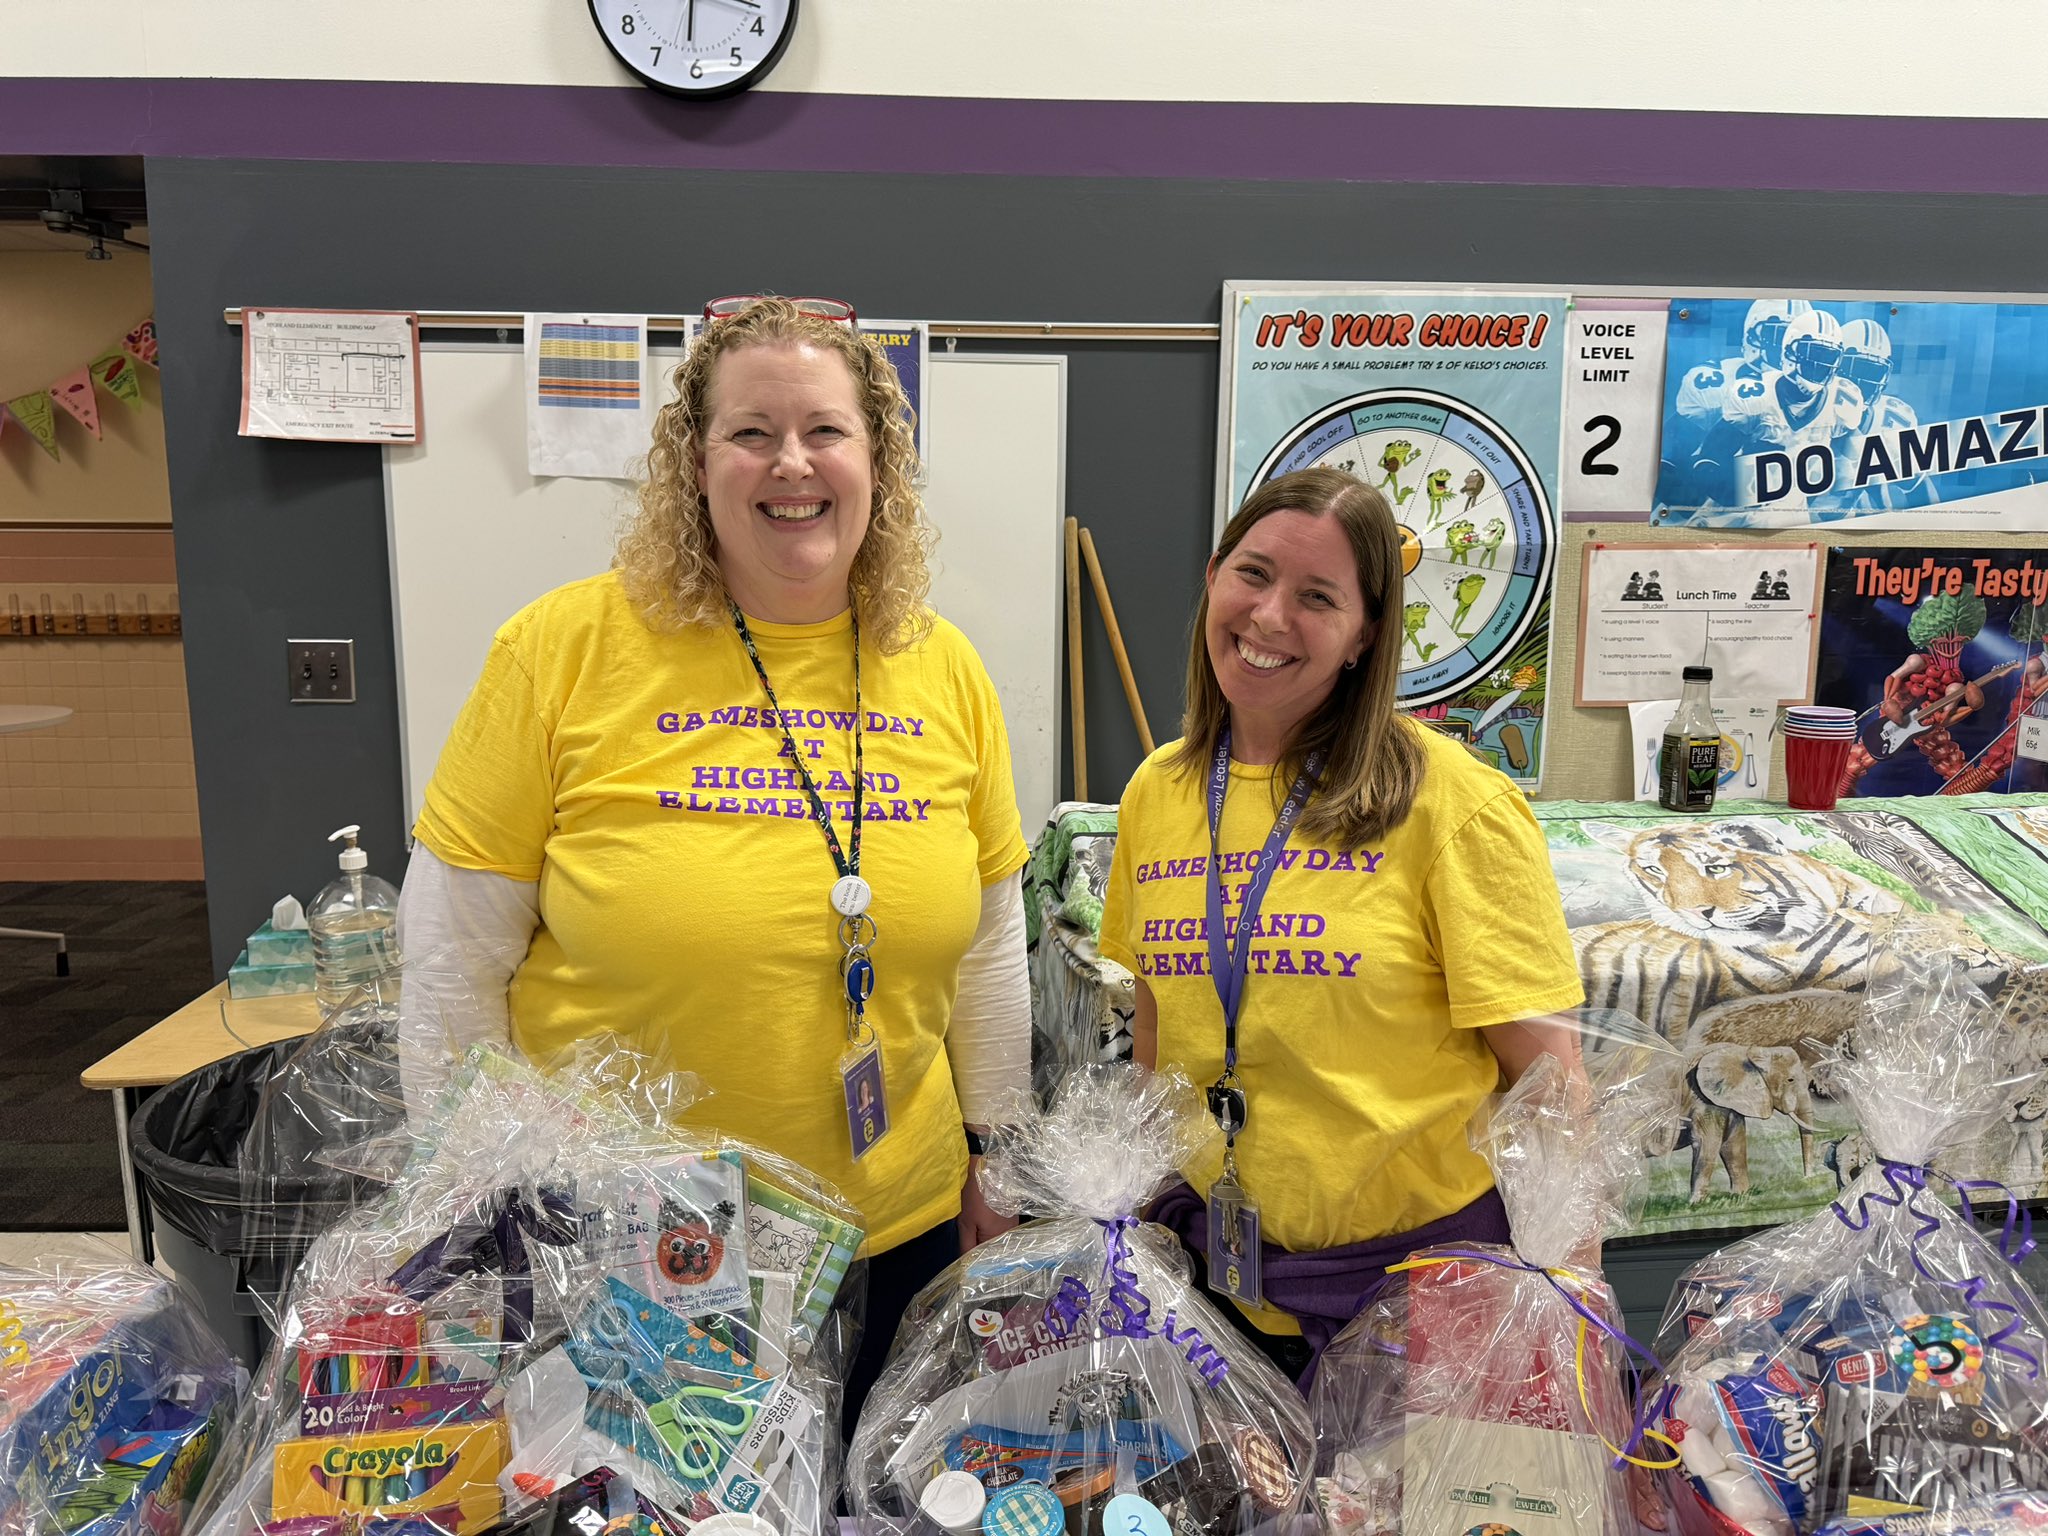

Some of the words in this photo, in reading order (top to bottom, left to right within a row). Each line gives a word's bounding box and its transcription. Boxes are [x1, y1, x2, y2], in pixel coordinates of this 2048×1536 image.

[621, 14, 636, 36] 8
[749, 16, 765, 37] 4
[650, 46, 662, 67] 7
[729, 47, 743, 67] 5
[689, 58, 703, 80] 6
[1256, 310, 1323, 347] IT'S
[1331, 313, 1414, 347] YOUR
[1583, 323, 1636, 338] VOICE
[1580, 345, 1635, 361] LEVEL
[1252, 361, 1268, 370] DO
[1270, 361, 1292, 370] YOU
[1294, 361, 1320, 370] HAVE
[1321, 361, 1329, 370] A
[1331, 361, 1360, 370] SMALL
[1363, 360, 1415, 370] PROBLEM?
[1418, 361, 1434, 370] TRY
[1436, 361, 1444, 370] 2
[1445, 361, 1462, 370] OF
[1463, 360, 1501, 370] KELSO'S
[1582, 368, 1631, 383] LIMIT
[1357, 416, 1371, 426] GO
[1371, 414, 1383, 422] TO
[1384, 411, 1420, 421] ANOTHER
[1420, 414, 1442, 426] GAME
[1306, 436, 1327, 454] COOL
[1327, 424, 1344, 439] OFF
[1465, 432, 1483, 447] TALK
[1485, 449, 1501, 466] OUT
[1580, 414, 1622, 476] 2
[1755, 444, 1834, 504] DO
[1853, 557, 1963, 605] They're
[1641, 602, 1669, 610] Student
[1676, 590, 1709, 600] Lunch
[1712, 590, 1737, 600] Time
[1412, 675, 1431, 687] WALK
[1431, 667, 1449, 683] AWAY
[866, 711, 925, 737] DAY
[2027, 726, 2041, 737] Milk
[777, 737, 825, 759] AT
[1692, 746, 1717, 757] PURE
[2025, 739, 2038, 751] 65¢
[1212, 745, 1228, 790] Leader
[1303, 849, 1384, 874] DAY
[996, 1325, 1031, 1354] ICE
[98, 1389, 119, 1424] ZING
[304, 1405, 334, 1429] 20
[775, 1394, 797, 1425] KIDS
[1873, 1402, 1890, 1421] SIZE
[749, 1389, 788, 1450] SCISSORS
[323, 1439, 444, 1476] Crayola
